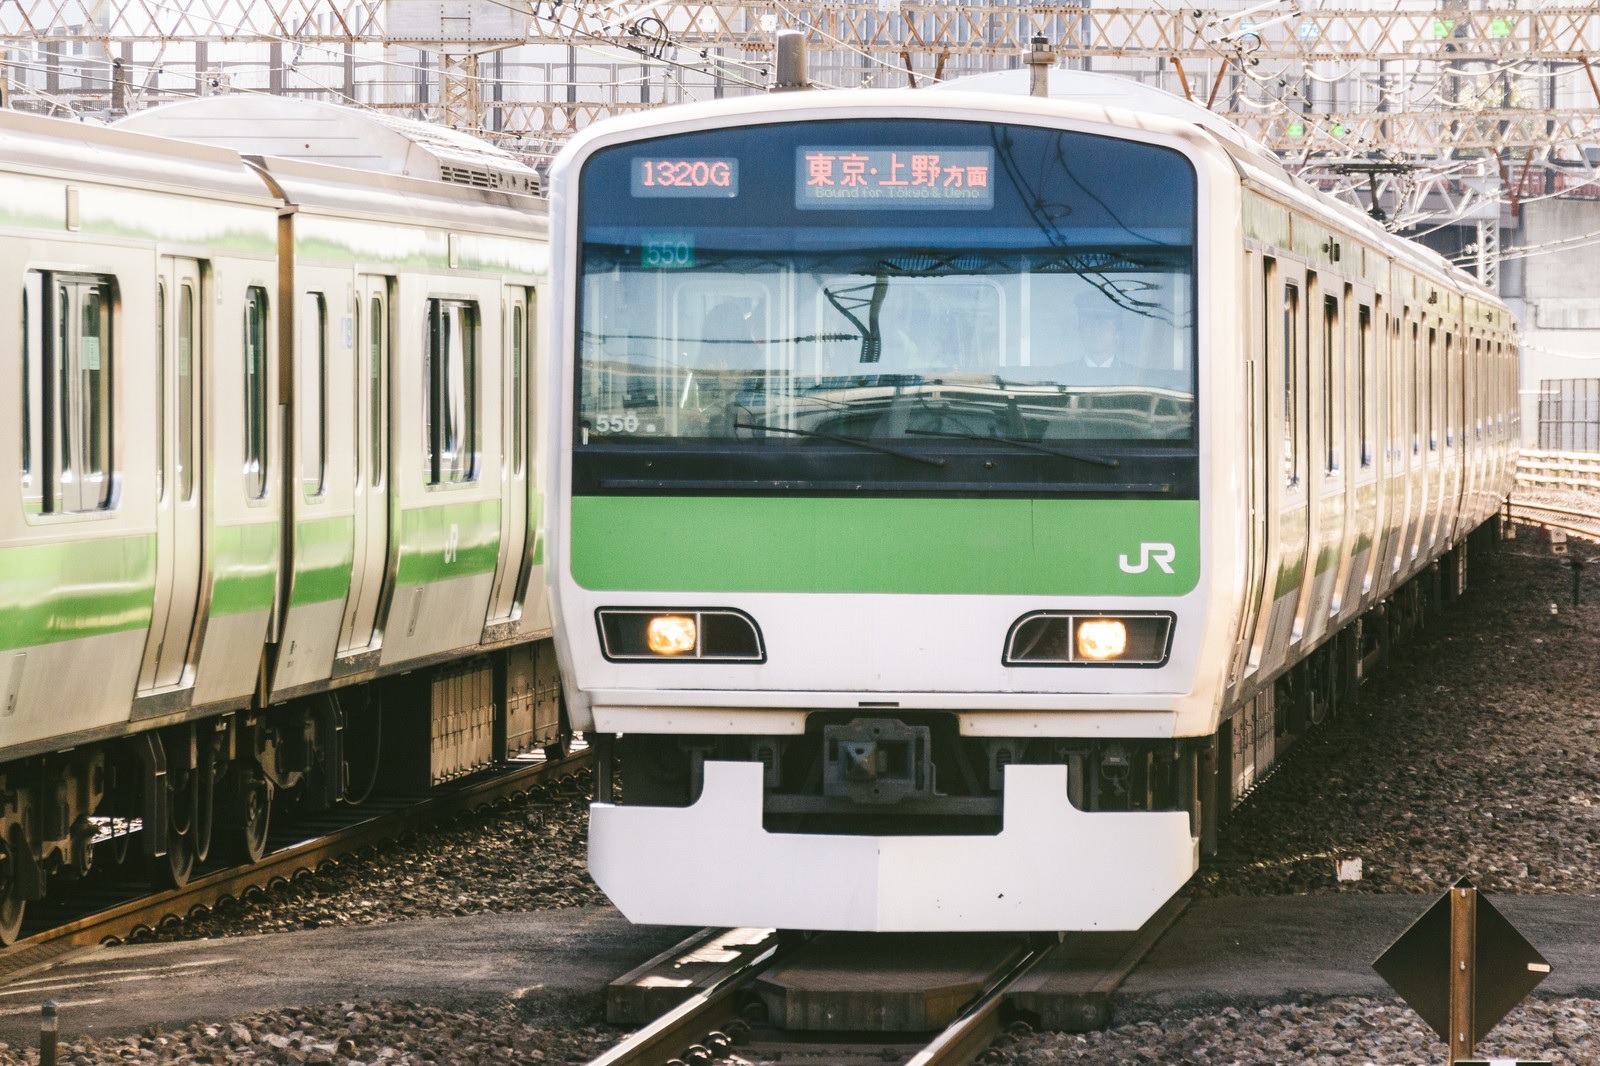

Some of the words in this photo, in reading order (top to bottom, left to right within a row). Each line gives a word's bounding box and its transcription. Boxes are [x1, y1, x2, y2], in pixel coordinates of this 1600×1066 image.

[643, 161, 731, 187] 1320G
[815, 187, 859, 198] Bound
[862, 187, 882, 198] for
[945, 187, 979, 198] Ueno
[647, 241, 689, 264] 550
[444, 523, 459, 564] JR
[1119, 542, 1176, 574] JR
